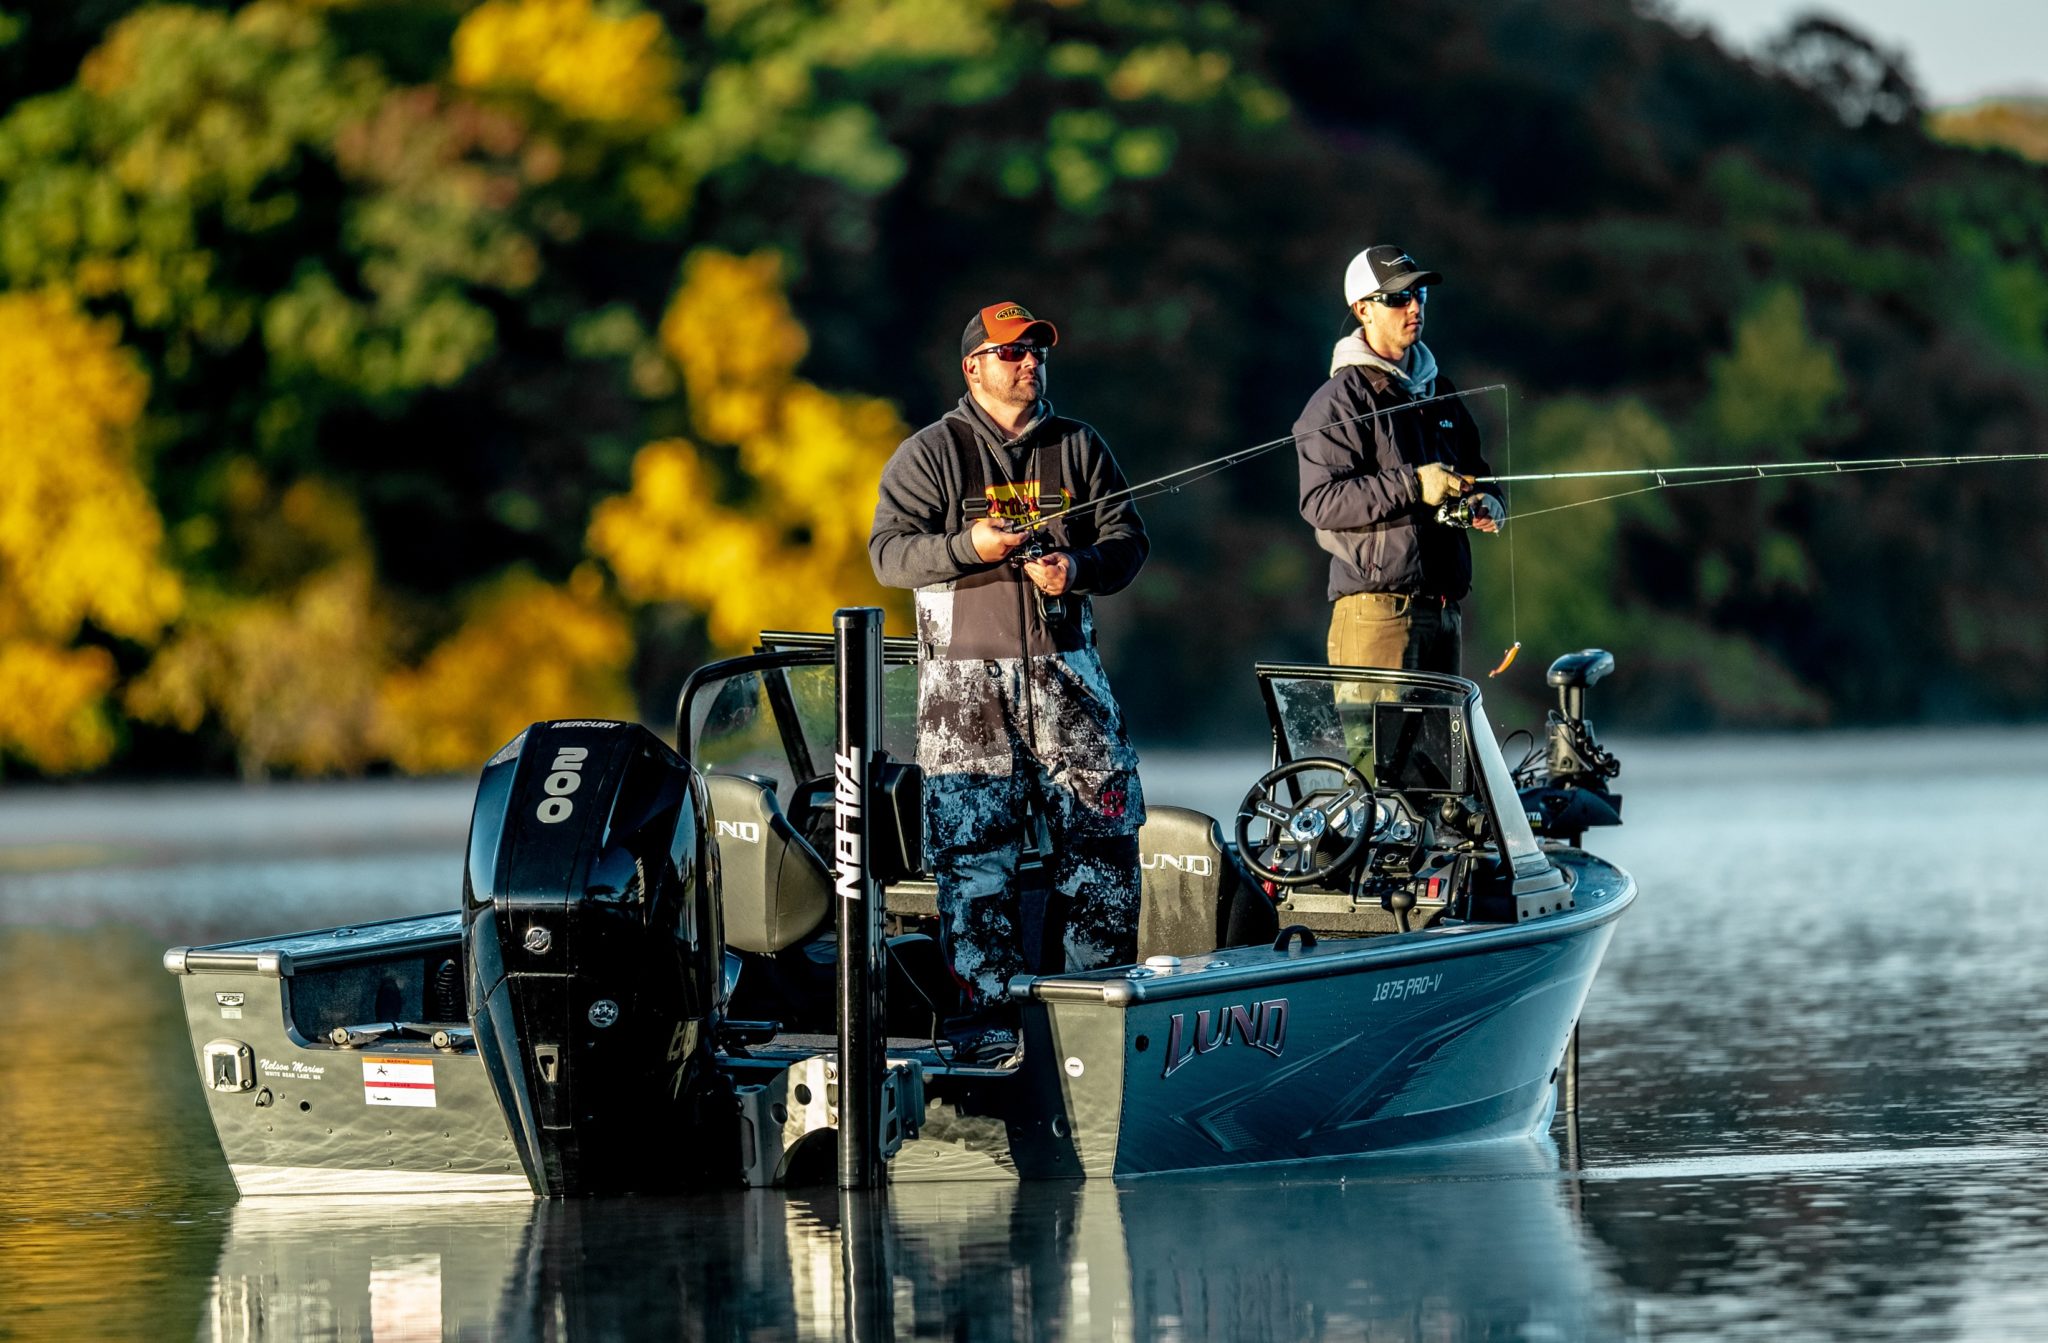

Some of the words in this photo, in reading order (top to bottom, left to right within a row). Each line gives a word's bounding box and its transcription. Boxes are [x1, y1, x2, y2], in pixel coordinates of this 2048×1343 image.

[551, 721, 620, 729] MERCURY
[536, 747, 589, 824] 200
[834, 746, 862, 900] TALON
[1525, 811, 1542, 821] OTA
[715, 820, 760, 844] ND
[1139, 853, 1213, 877] UND
[1372, 980, 1405, 1002] 1875
[1402, 973, 1443, 1001] PRO-V
[1161, 998, 1289, 1079] LUND
[260, 1058, 289, 1071] Nelson
[292, 1061, 325, 1074] Marine
